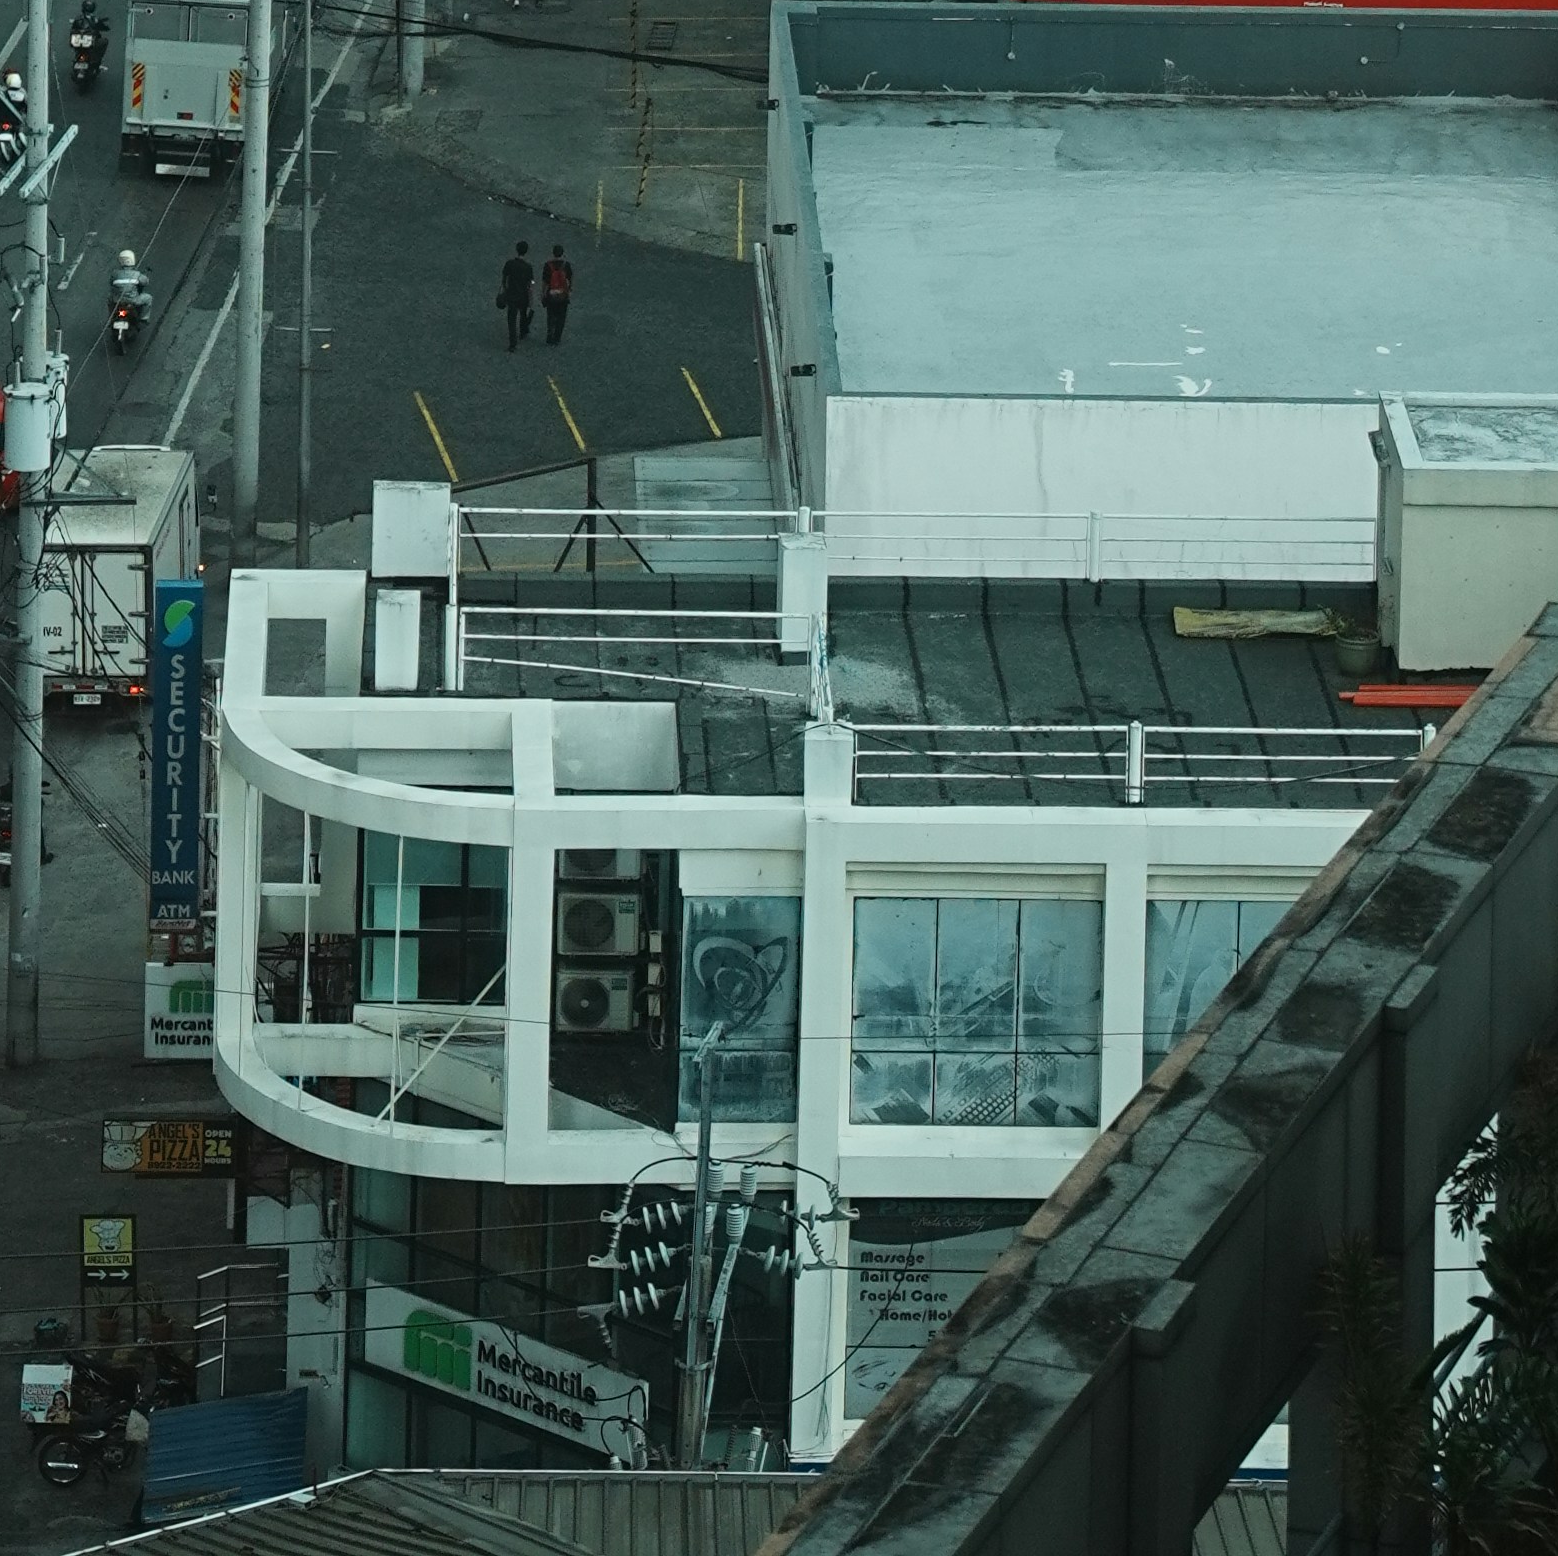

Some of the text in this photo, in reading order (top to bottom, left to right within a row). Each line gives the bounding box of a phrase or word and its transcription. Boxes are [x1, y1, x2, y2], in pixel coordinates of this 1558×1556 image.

[166, 653, 187, 864] SECURITY
[151, 870, 195, 886] BANK
[156, 904, 191, 918] ATM
[148, 1123, 200, 1139] ANGEL'S
[204, 1129, 232, 1138] OPEN
[149, 1139, 201, 1161] PIZZA
[204, 1140, 232, 1157] 24
[112, 1255, 130, 1264] PIZZA
[860, 1251, 925, 1267] Massage
[860, 1271, 930, 1283] Nail Care
[859, 1290, 948, 1302] Facial Care
[477, 1340, 598, 1406] Mercantile
[477, 1370, 585, 1432] Insurance
